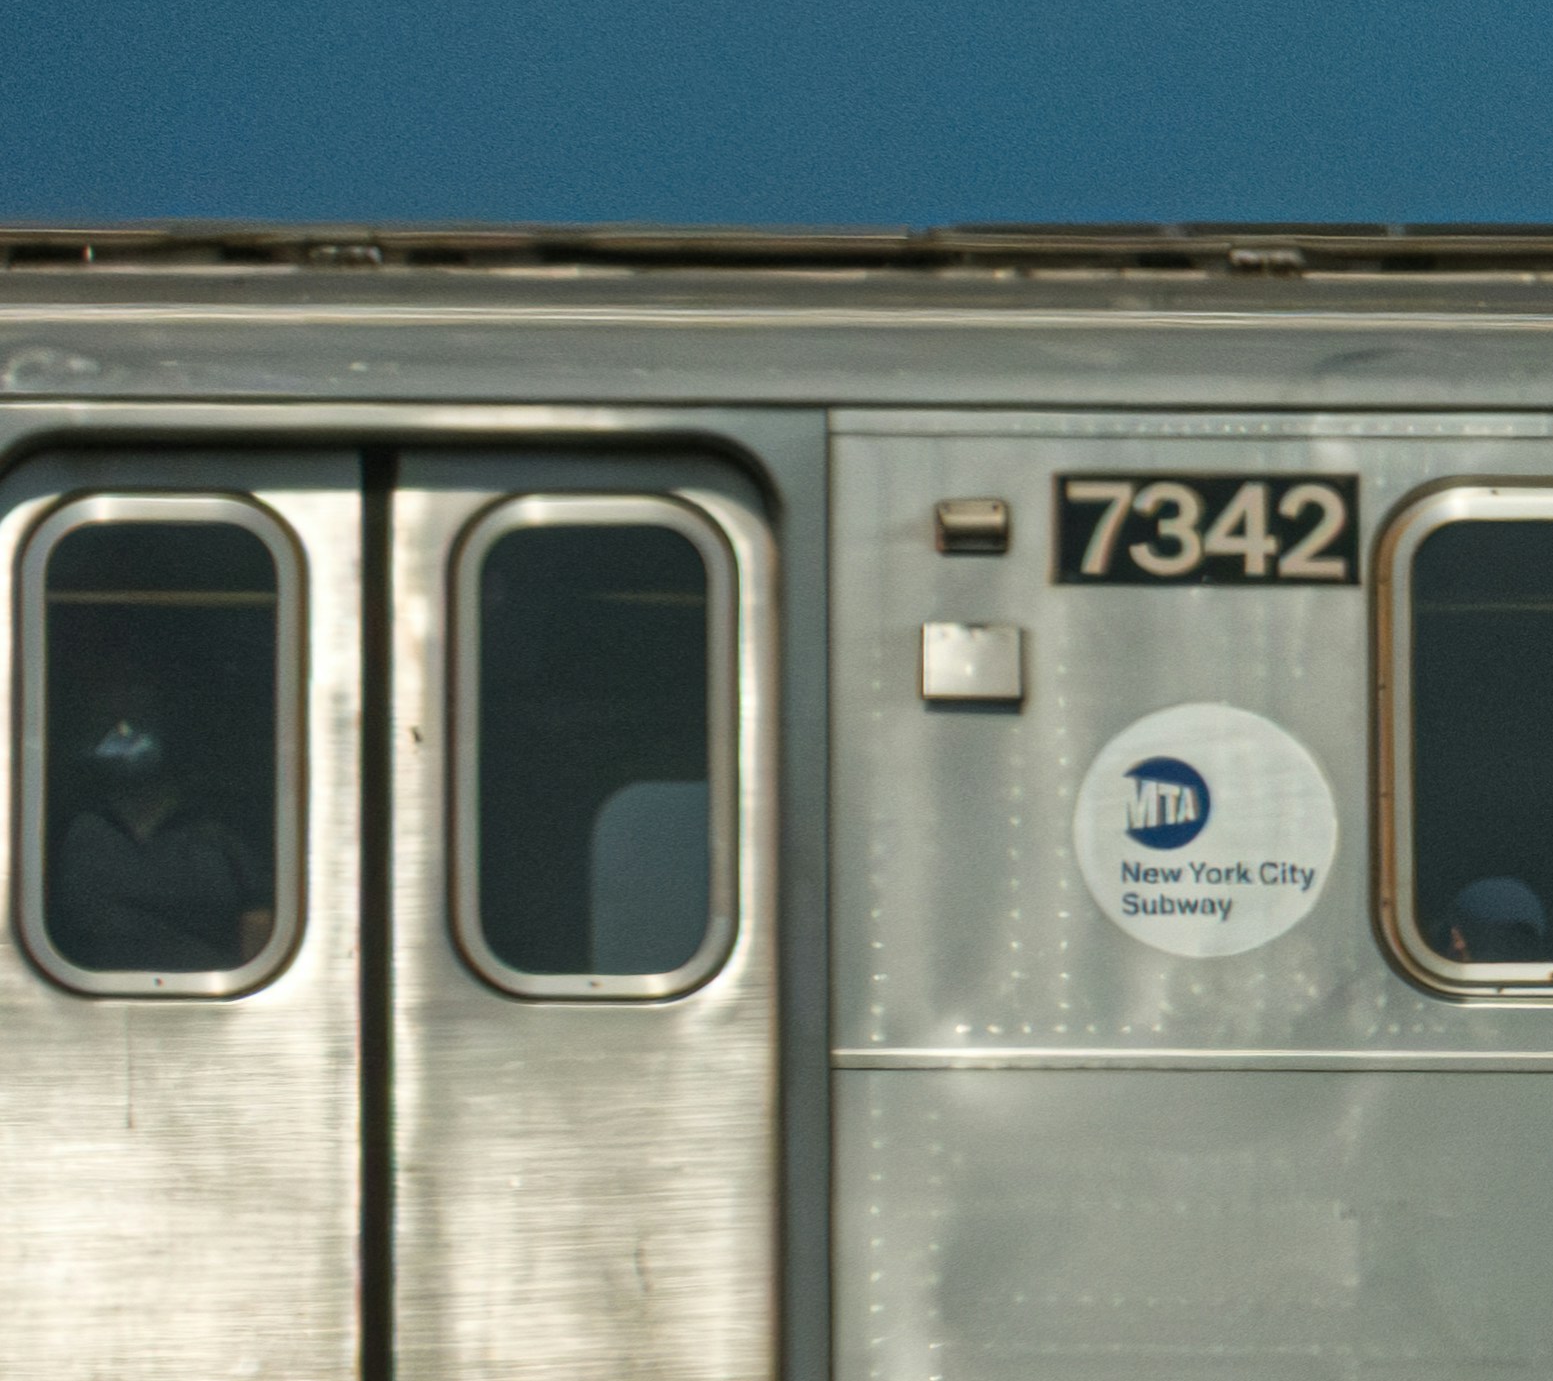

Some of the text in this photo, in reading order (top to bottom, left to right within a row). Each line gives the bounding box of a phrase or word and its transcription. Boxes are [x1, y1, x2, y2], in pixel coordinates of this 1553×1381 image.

[1065, 481, 1348, 577] 7342
[1122, 775, 1200, 830] MTA
[1121, 861, 1315, 892] New York City
[1121, 892, 1233, 922] Subway
